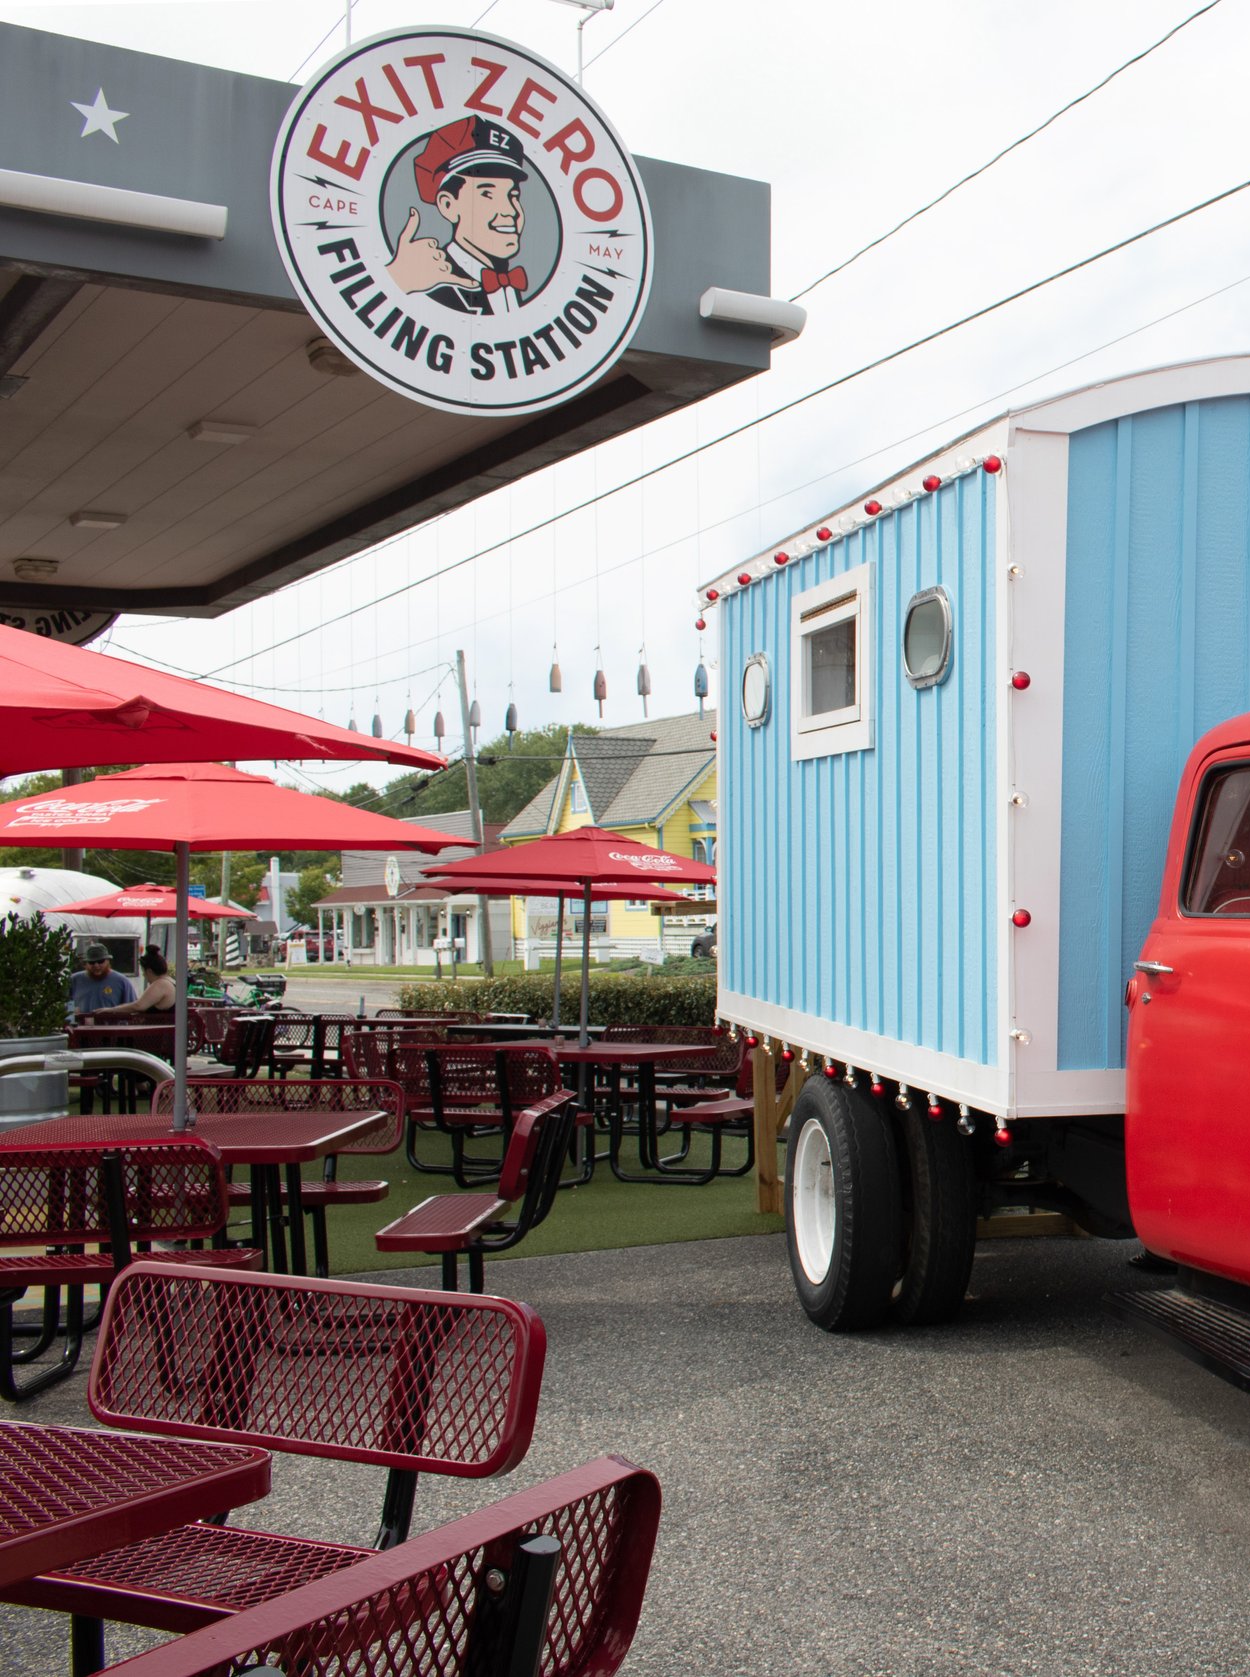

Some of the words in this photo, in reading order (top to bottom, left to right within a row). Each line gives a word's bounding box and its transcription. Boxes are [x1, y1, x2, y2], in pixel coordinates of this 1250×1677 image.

[306, 53, 446, 182] EXIT
[463, 56, 624, 223] ZERO
[489, 129, 510, 150] EZ
[308, 195, 358, 215] CAPE
[588, 243, 623, 261] MAY
[317, 237, 455, 375] FILLING
[470, 273, 615, 381] STATION
